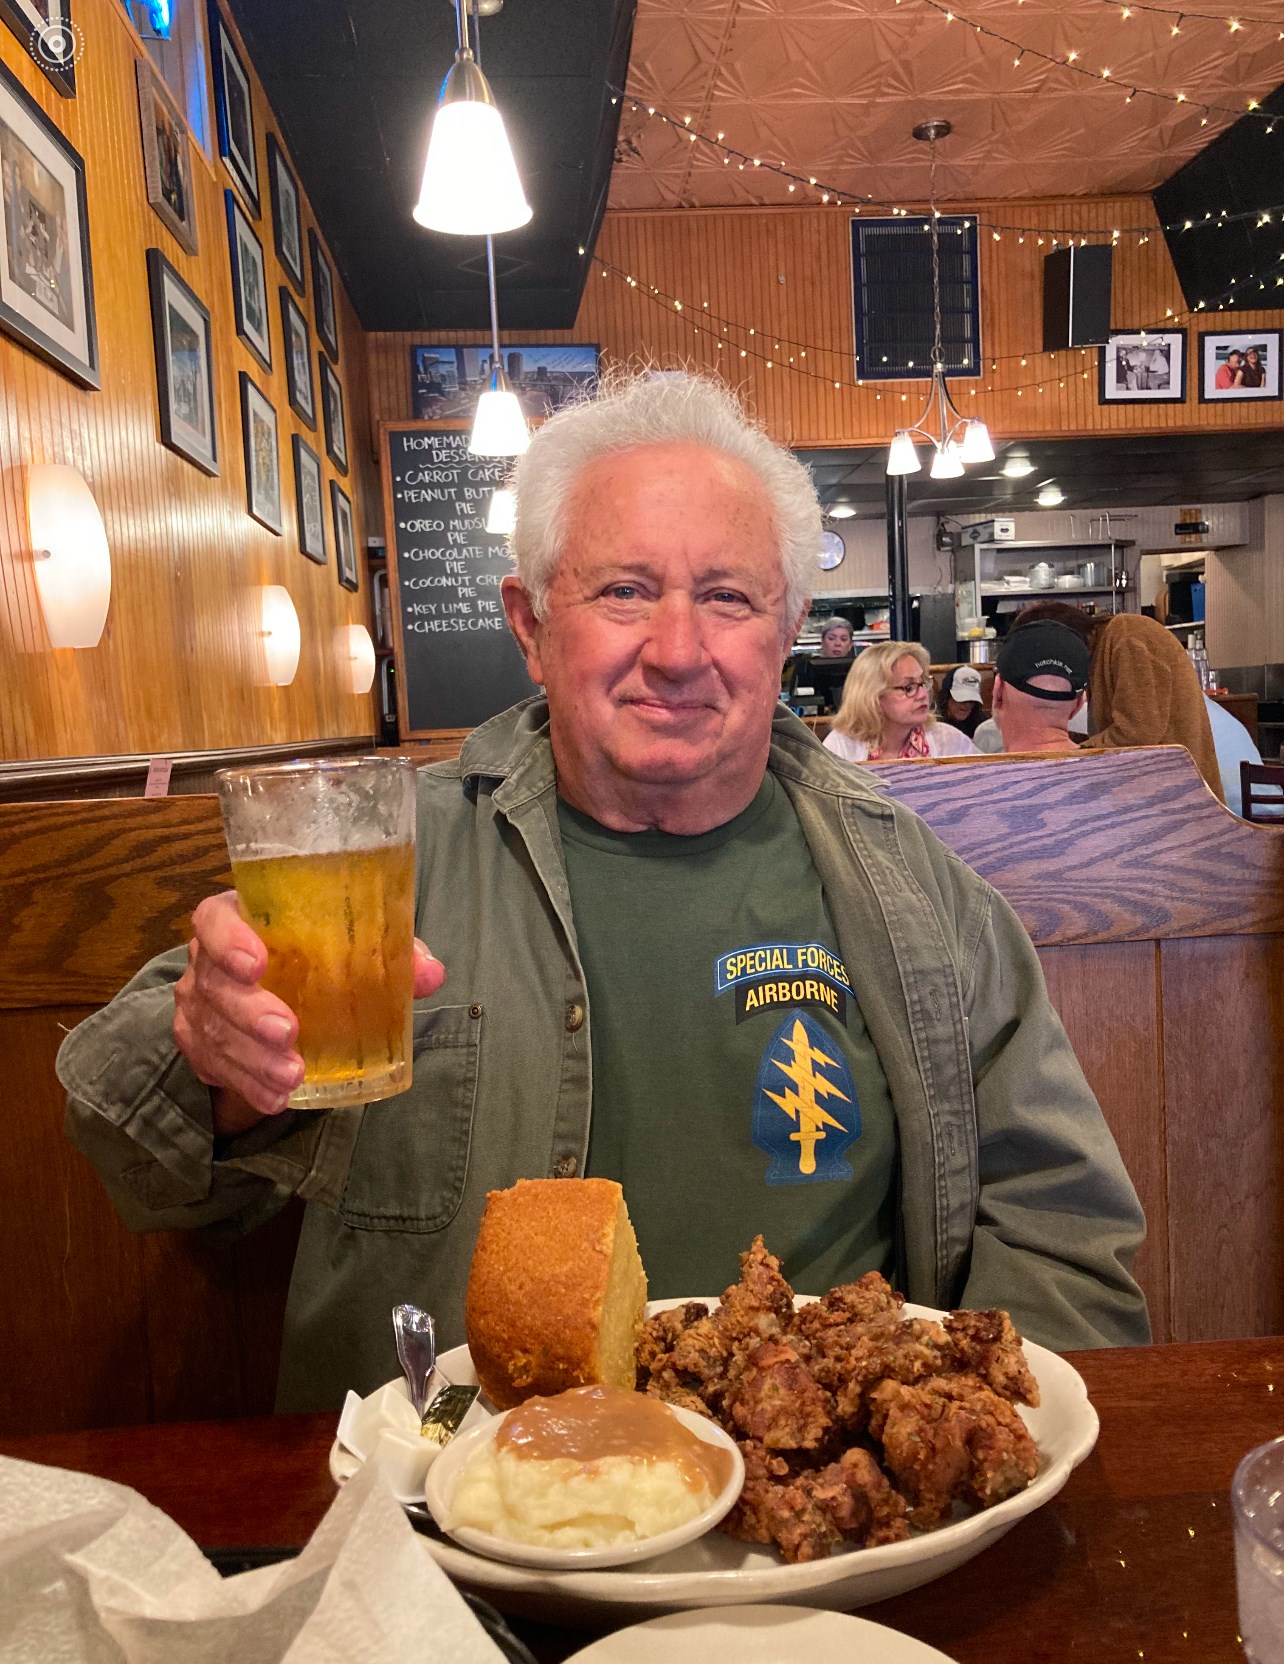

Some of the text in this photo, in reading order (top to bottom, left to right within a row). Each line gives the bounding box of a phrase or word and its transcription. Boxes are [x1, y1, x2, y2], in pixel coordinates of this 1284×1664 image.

[403, 435, 471, 451] HOMEMAD
[405, 468, 503, 485] CARROT CAKE
[403, 488, 458, 503] PEANUT
[455, 502, 476, 515] PIE
[406, 517, 486, 532] OREO MUDSL
[447, 531, 468, 545] PIE
[410, 546, 483, 561] CHOCOLATE
[446, 561, 468, 574] PIE
[409, 574, 500, 590] COCONUT CRE
[457, 586, 478, 598] PIE
[413, 600, 500, 616] KEY LIME PIE
[414, 617, 503, 633] CHEESECAKE
[726, 947, 850, 986] SPECIAL FORCES
[745, 980, 839, 1013] AIRBORNE
